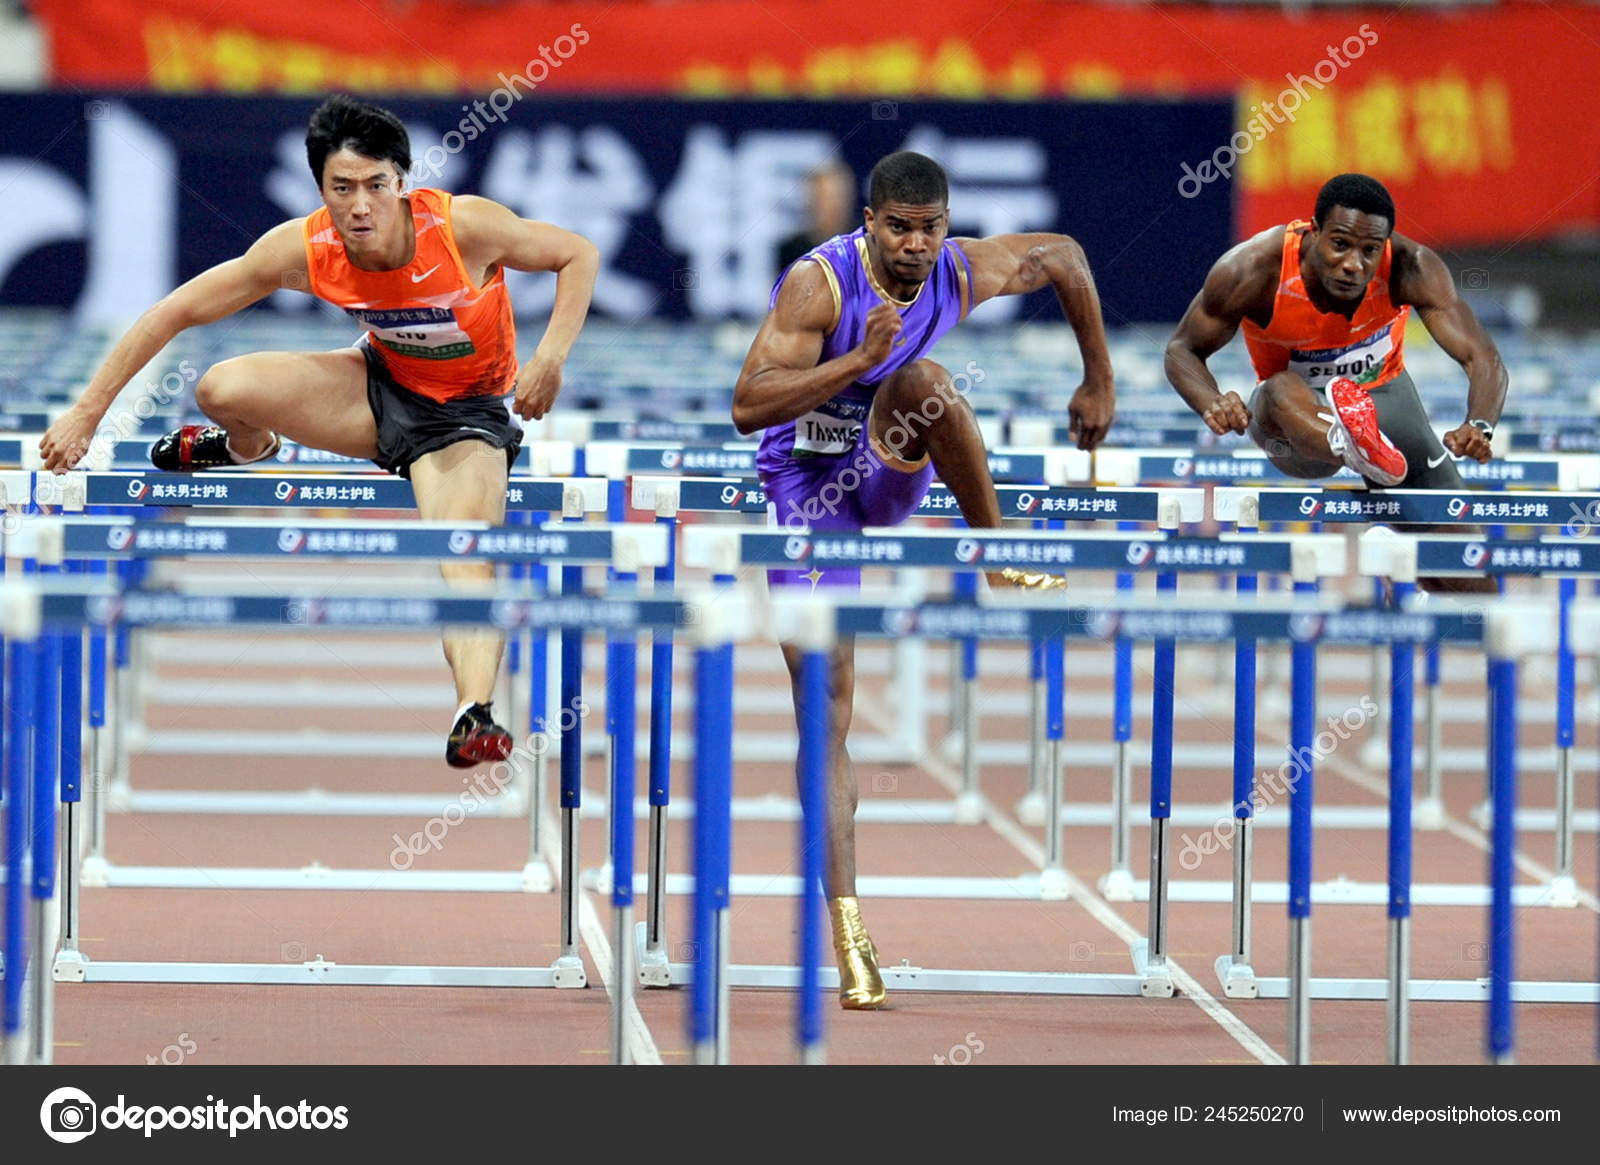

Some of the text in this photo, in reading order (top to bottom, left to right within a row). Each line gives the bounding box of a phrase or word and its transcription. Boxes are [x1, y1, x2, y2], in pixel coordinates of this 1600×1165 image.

[152, 484, 228, 498] 高夫男士护肤
[300, 486, 376, 501] 高夫男士护肤
[919, 494, 959, 509] 男士护
[1041, 497, 1117, 512] 高夫男士护肤
[1324, 500, 1400, 515] 高夫男士护肤
[1472, 503, 1549, 518] 高夫男士护肤
